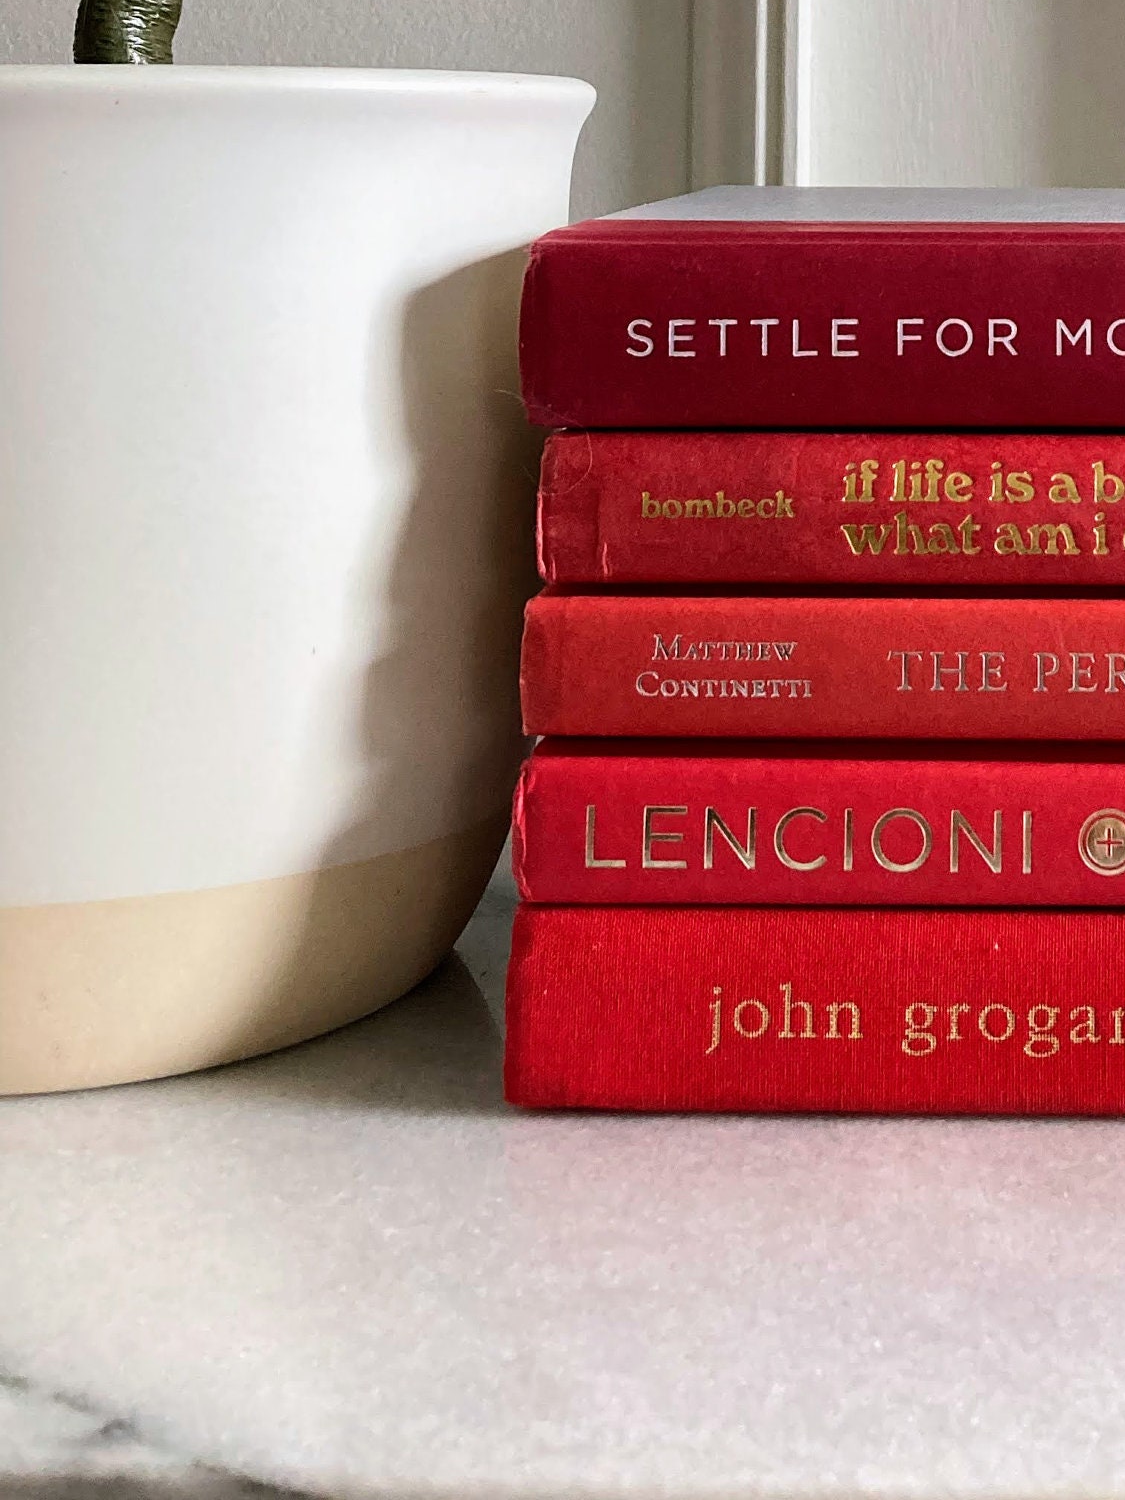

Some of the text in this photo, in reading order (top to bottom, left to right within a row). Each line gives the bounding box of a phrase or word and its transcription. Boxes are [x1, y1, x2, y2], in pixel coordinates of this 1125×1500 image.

[626, 318, 860, 358] SETTLE
[897, 318, 1020, 358] FOR
[842, 460, 880, 503] if
[893, 461, 974, 503] life
[990, 463, 1037, 504] is
[1049, 472, 1081, 505] a
[641, 492, 795, 519] bombeck
[840, 511, 981, 556] what
[994, 523, 1080, 556] am
[1093, 512, 1109, 556] i
[887, 650, 1009, 692] THE
[585, 805, 1032, 874] LENCIONI
[706, 982, 863, 1054] john
